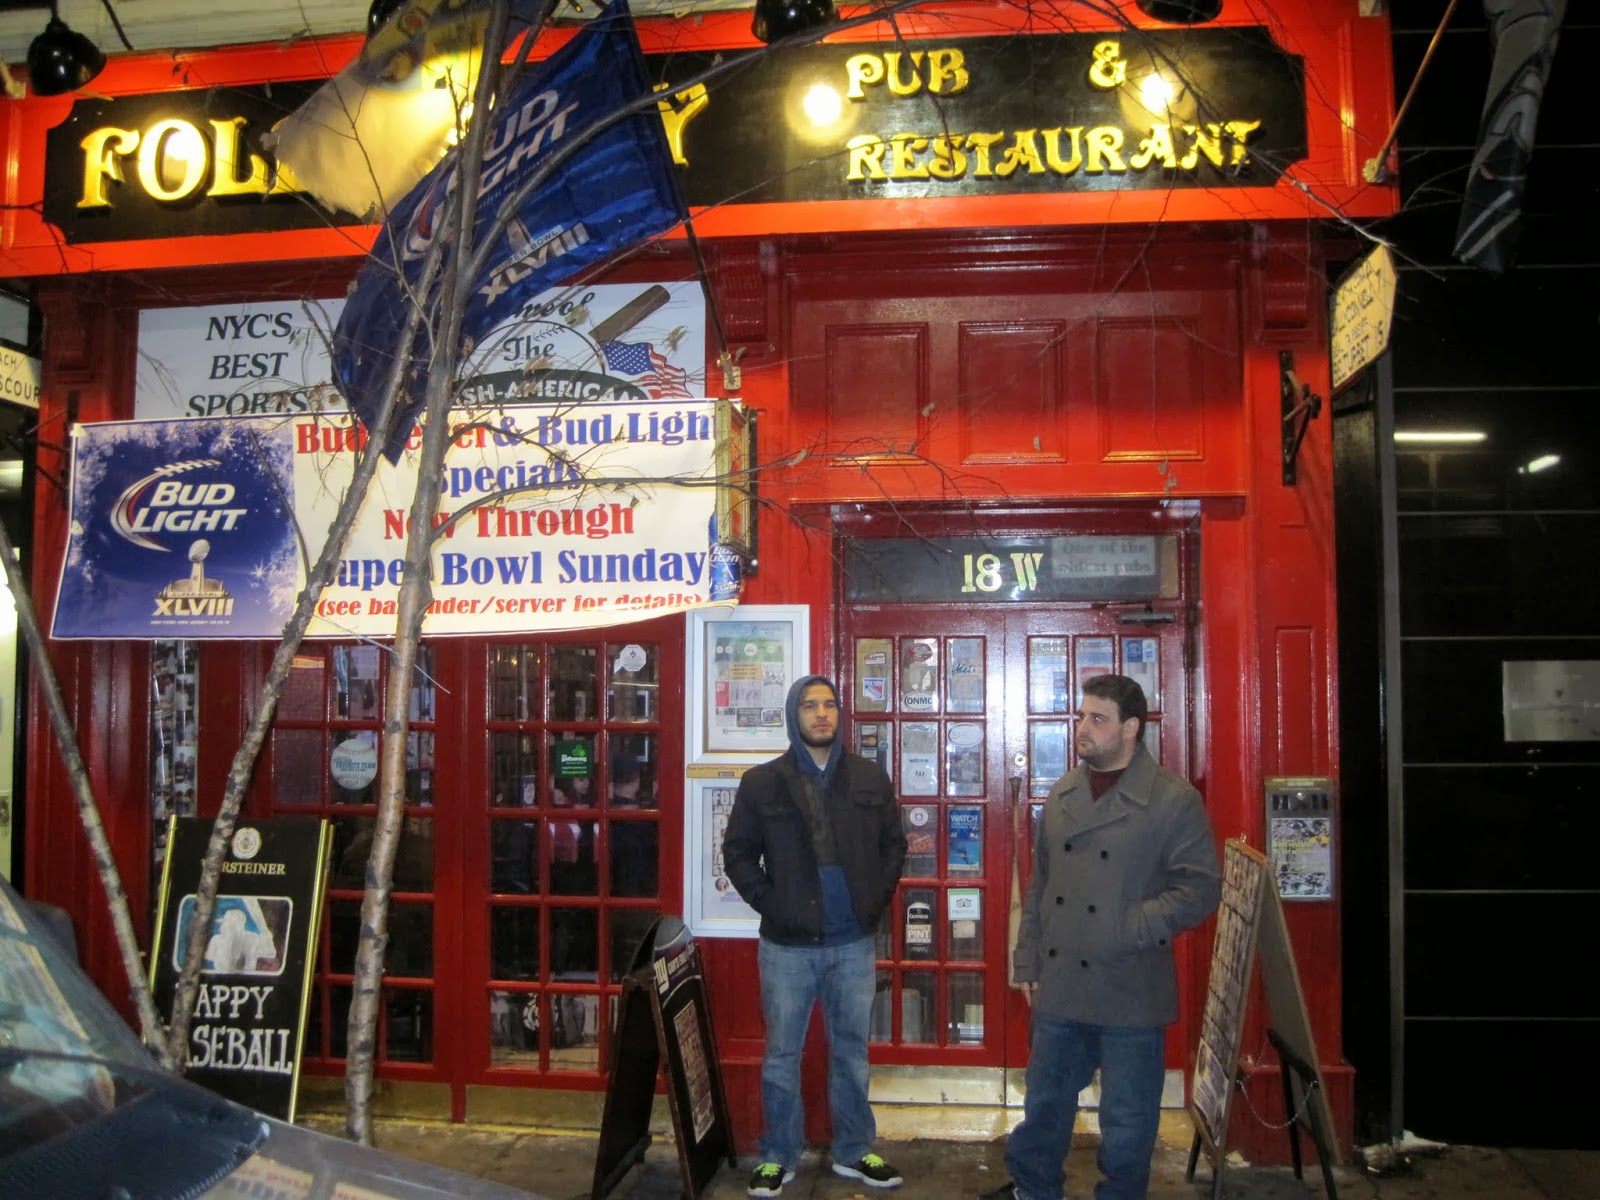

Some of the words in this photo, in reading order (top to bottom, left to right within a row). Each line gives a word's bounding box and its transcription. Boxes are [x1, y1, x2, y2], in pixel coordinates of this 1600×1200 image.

[845, 46, 969, 100] PUB
[1088, 40, 1125, 89] &
[77, 116, 302, 207] FOL
[845, 119, 1262, 181] RESTAURANT
[530, 231, 558, 250] BOWL
[205, 312, 293, 341] NYC'S
[0, 353, 17, 367] CH
[502, 336, 555, 362] The
[209, 352, 288, 380] BEST
[186, 391, 308, 417] SPORTS
[493, 416, 523, 447] &
[537, 413, 612, 447] Bud
[150, 481, 236, 507] BUD
[131, 507, 247, 532] LIGHT
[384, 509, 456, 539] Nw
[472, 503, 634, 540] Through
[441, 551, 542, 586] Bowl
[558, 549, 706, 586] Sunday
[961, 554, 1001, 592] 18
[1010, 553, 1044, 591] W
[152, 598, 234, 616] XLVIII
[318, 598, 362, 617] (see
[573, 594, 607, 612] for
[950, 815, 978, 823] WATCH
[221, 861, 286, 875] RSTEINER
[191, 984, 273, 1019] APPY
[186, 1025, 293, 1075] SEBALL
